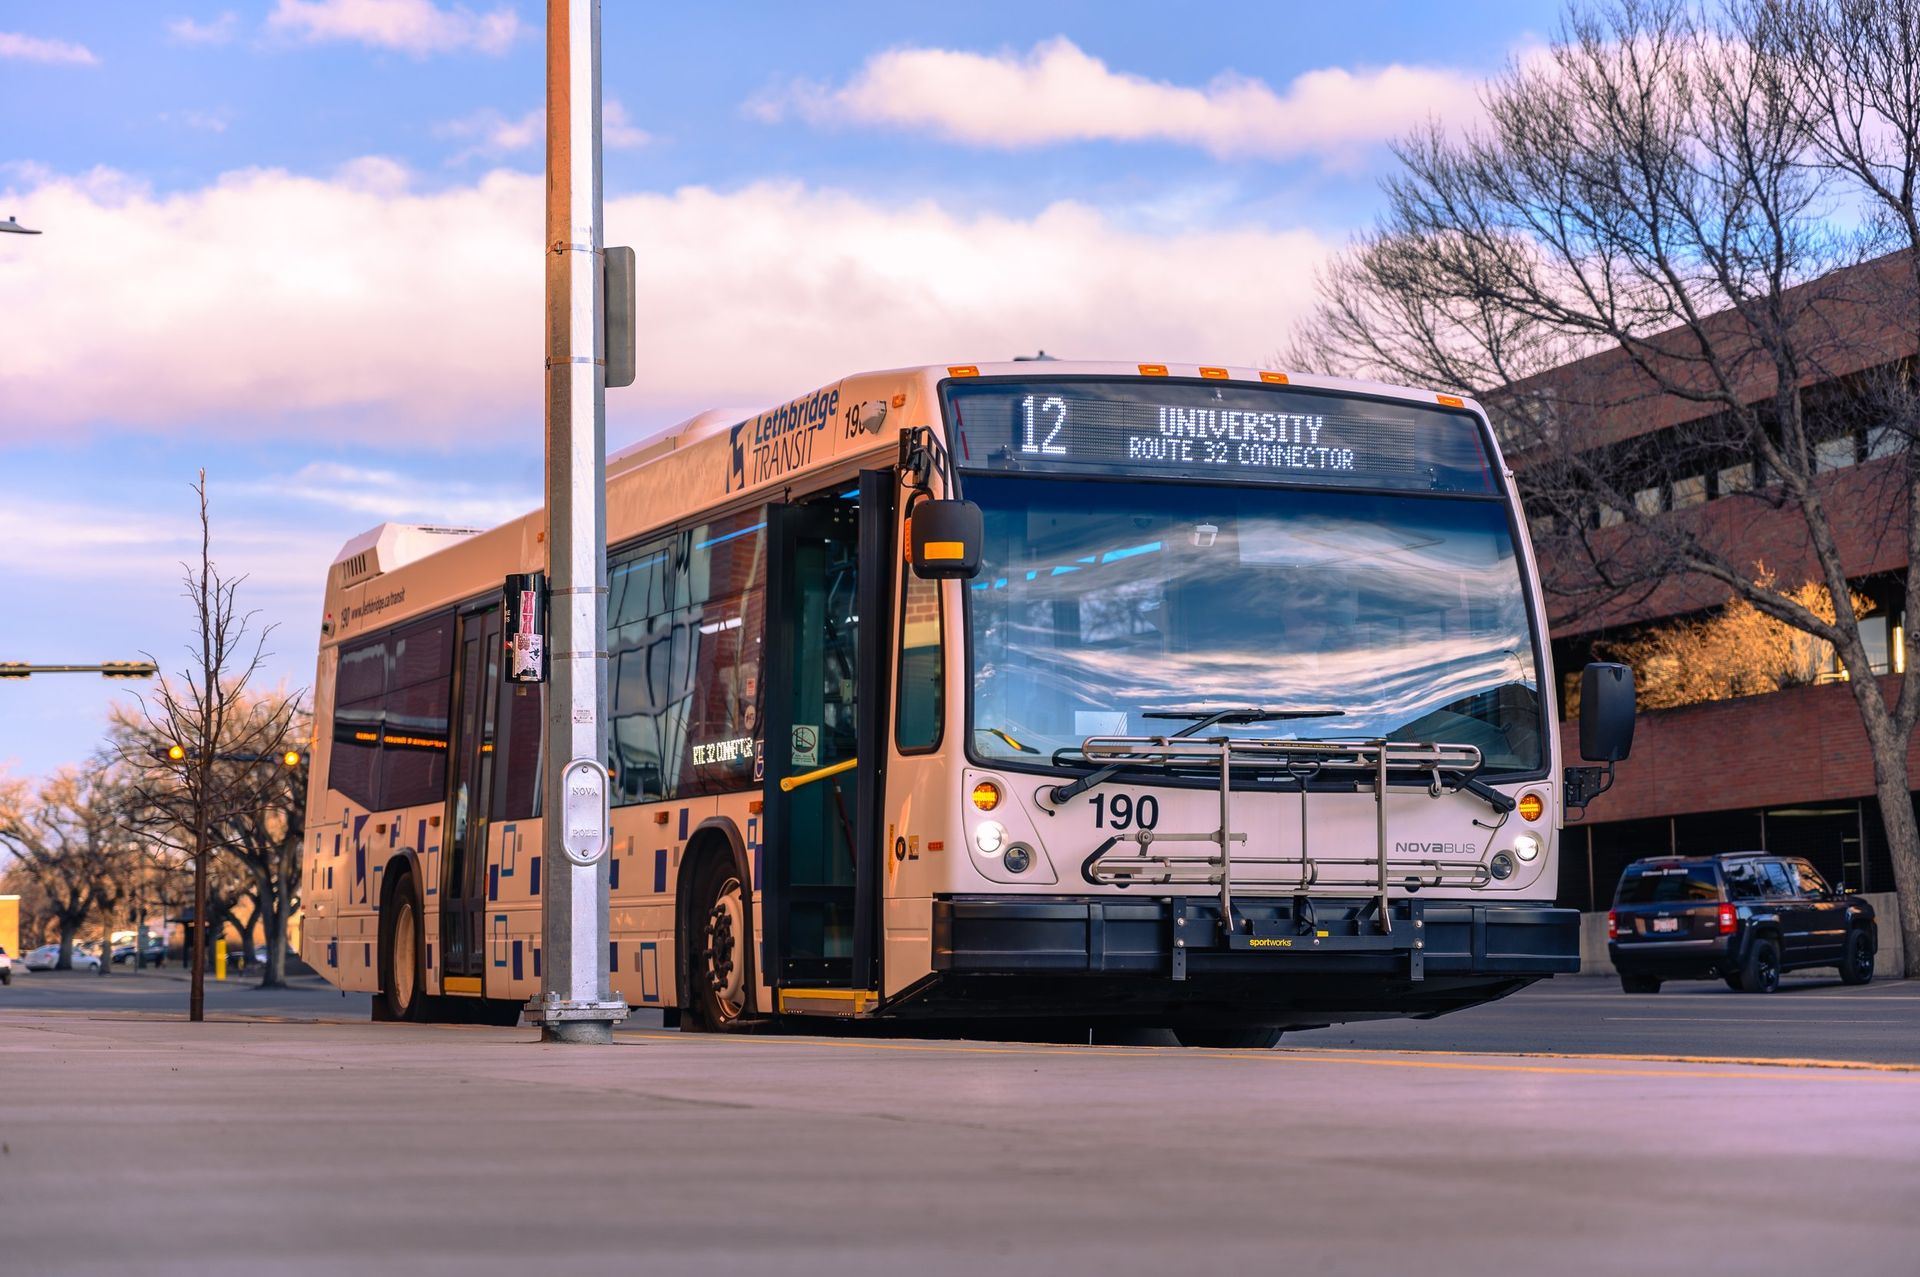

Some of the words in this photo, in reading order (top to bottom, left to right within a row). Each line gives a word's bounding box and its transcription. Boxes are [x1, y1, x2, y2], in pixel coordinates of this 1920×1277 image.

[755, 388, 838, 445] Lethbridge
[1022, 395, 1066, 454] 12
[1159, 407, 1323, 444] UNIVERSITY
[753, 425, 817, 484] TRANSIT
[1129, 437, 1194, 462] ROUTE
[1203, 440, 1229, 464] 32
[1237, 443, 1355, 470] CONNECTOR
[692, 744, 706, 766] RTE
[706, 742, 716, 763] 32
[572, 787, 598, 796] NOVA
[1088, 792, 1159, 830] 190
[1249, 938, 1292, 947] sportworks
